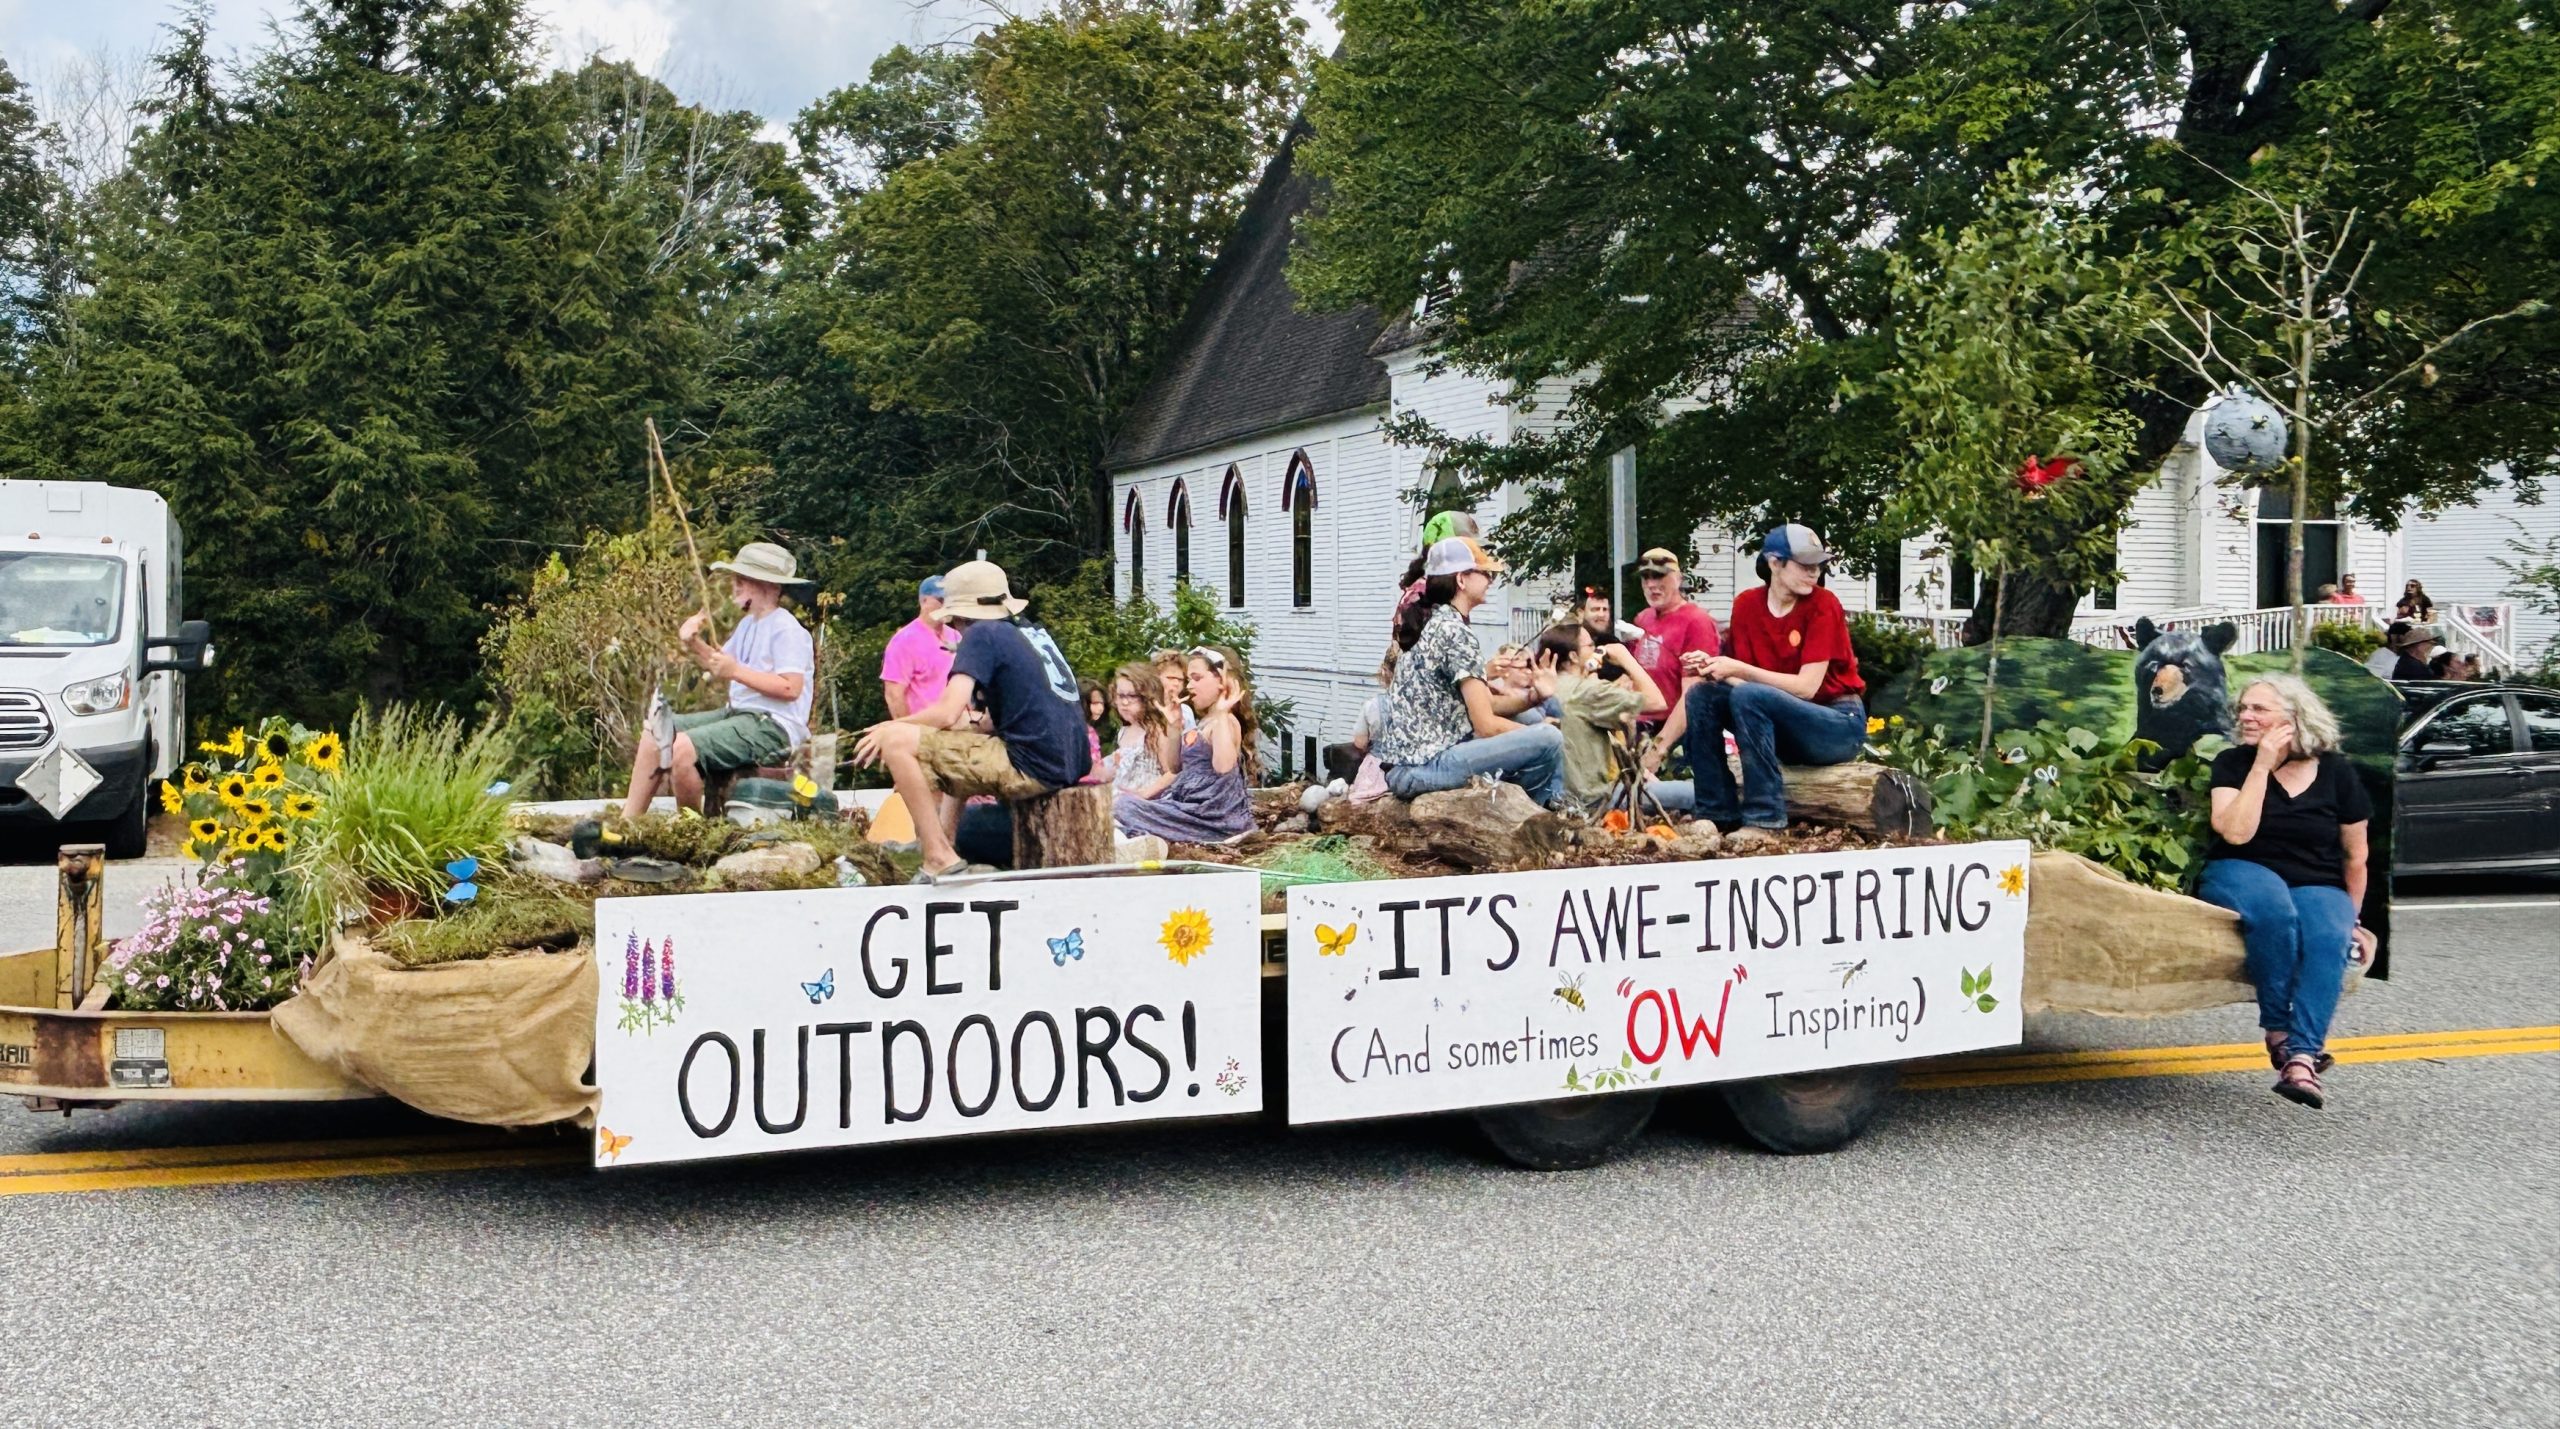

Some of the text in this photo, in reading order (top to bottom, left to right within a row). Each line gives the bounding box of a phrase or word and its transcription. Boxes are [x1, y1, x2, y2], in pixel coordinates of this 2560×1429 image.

[860, 901, 1019, 999] GET
[1378, 863, 1992, 981] IT'S AWE-INSPIRING
[677, 1001, 1201, 1139] OUTDOORS!
[1330, 962, 1927, 1084] (And sometimes "OW" Inspiring)
